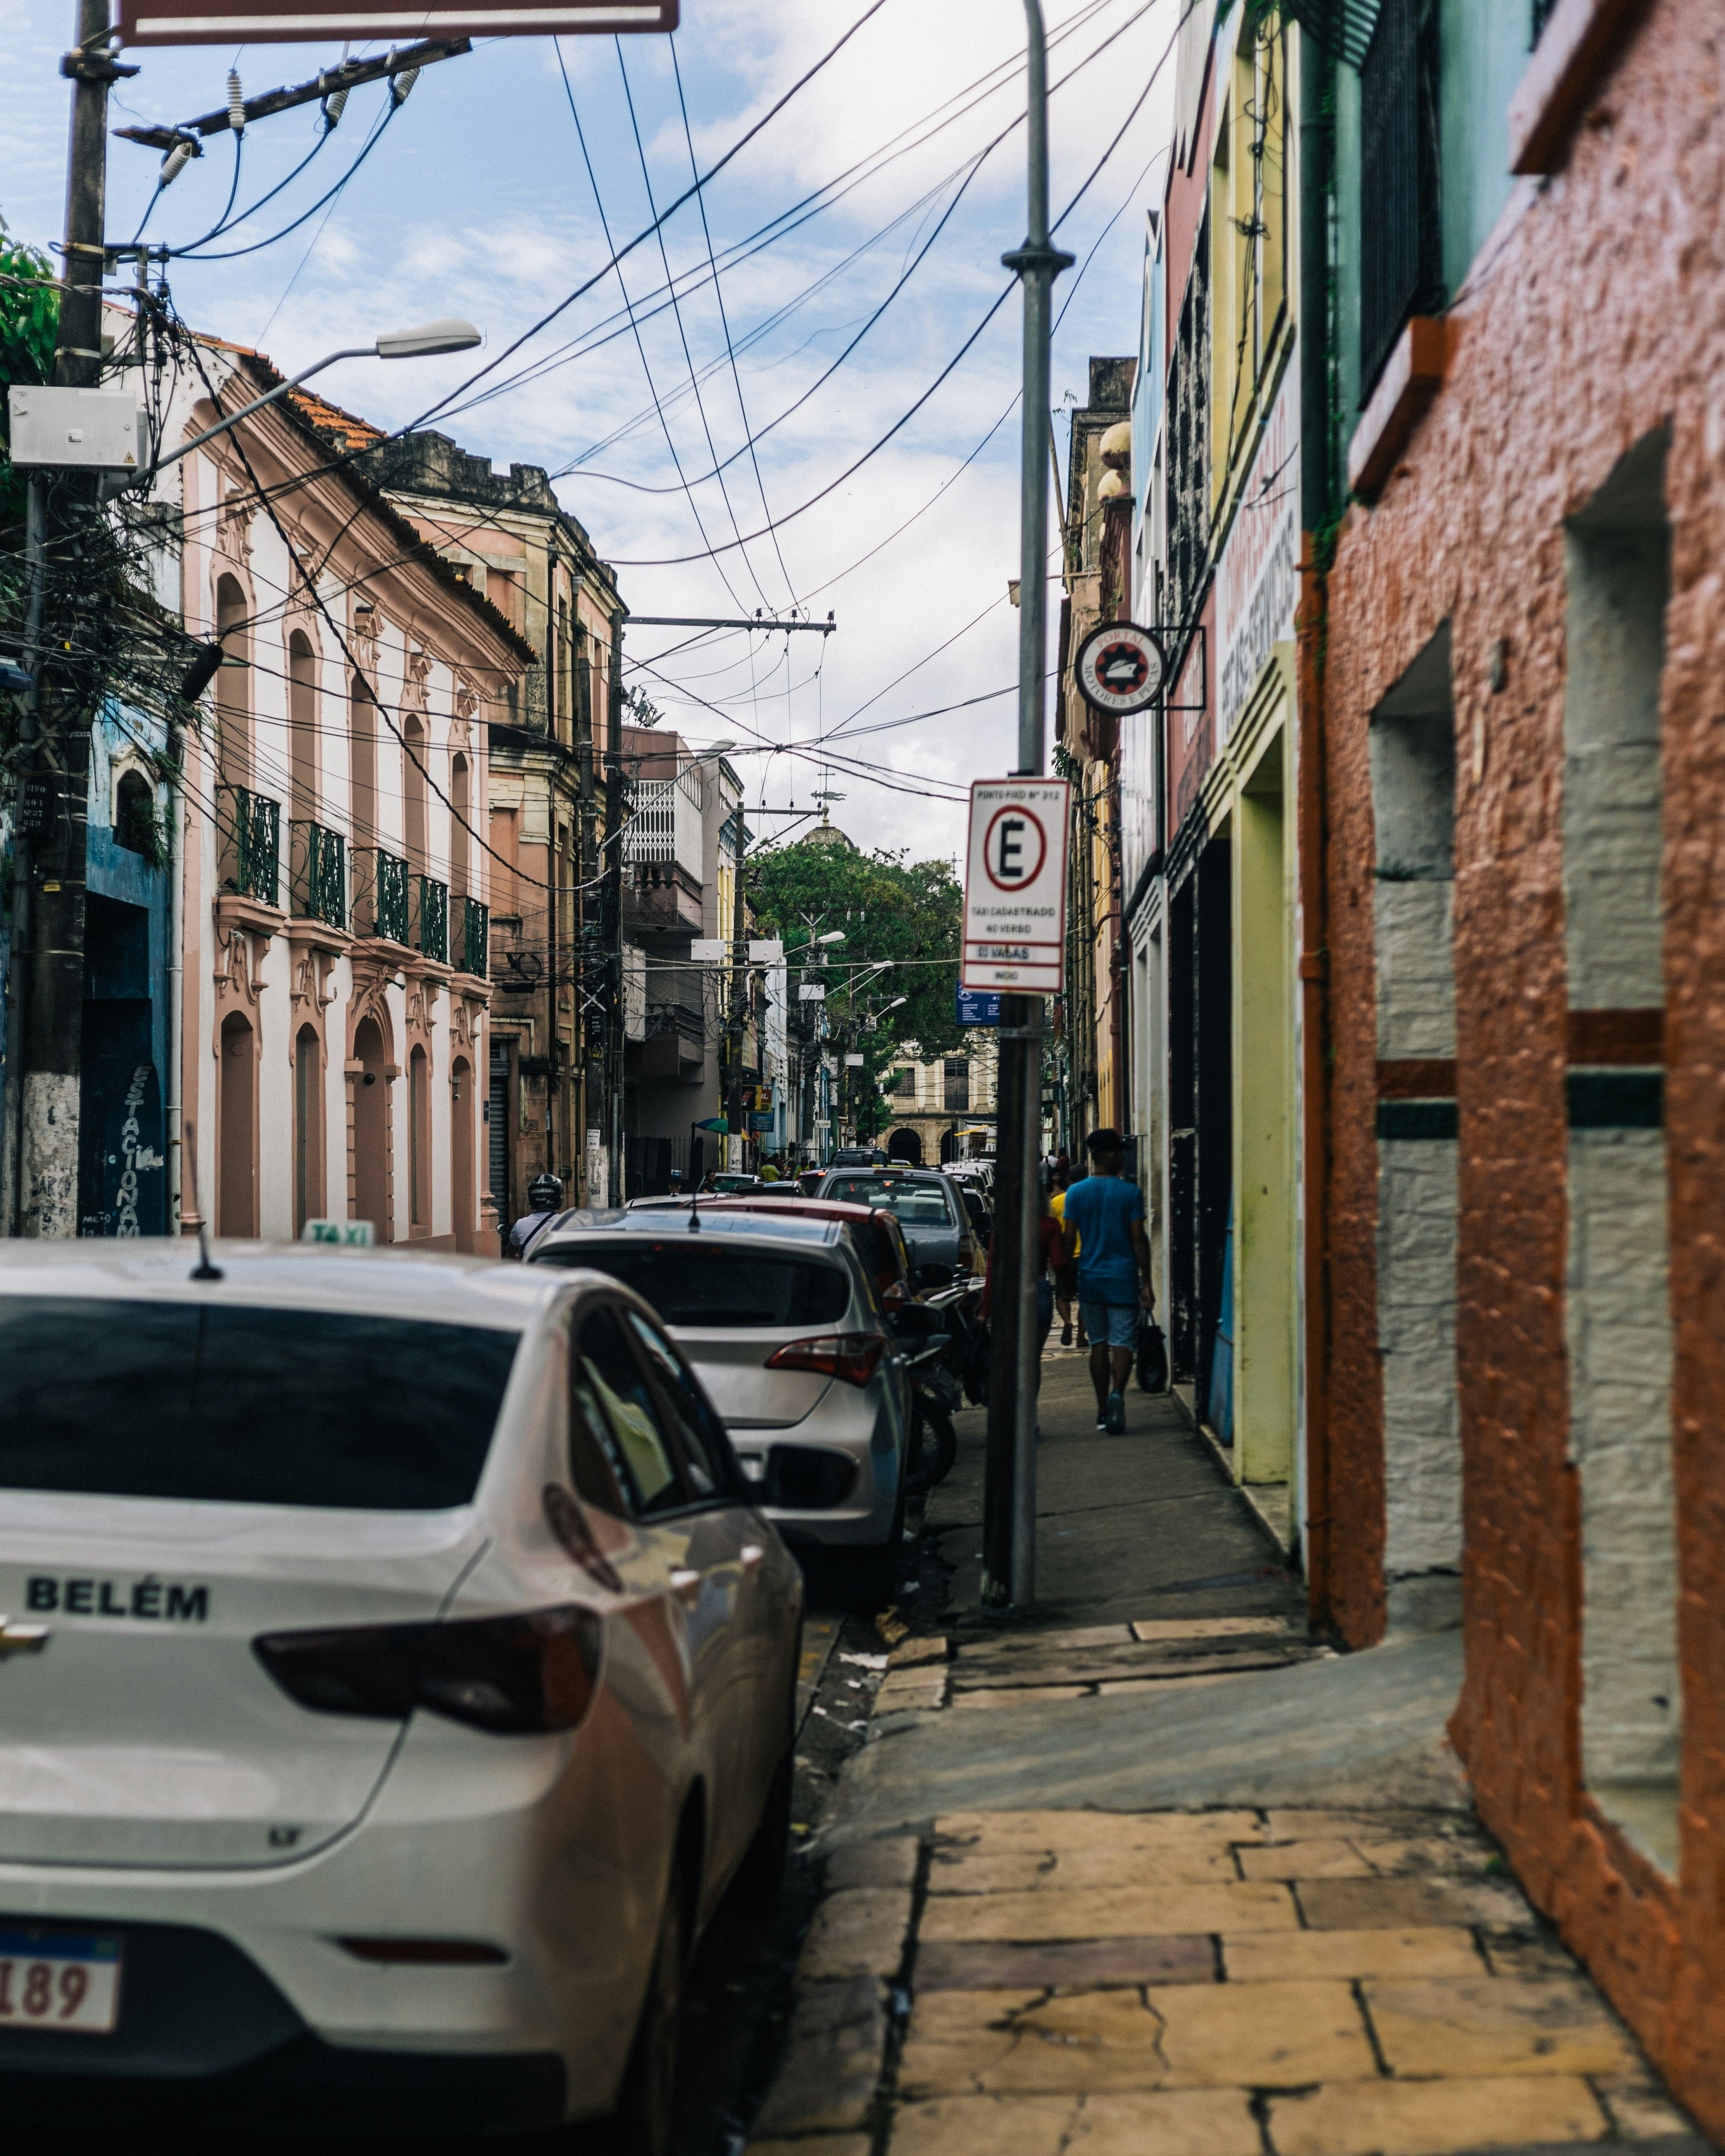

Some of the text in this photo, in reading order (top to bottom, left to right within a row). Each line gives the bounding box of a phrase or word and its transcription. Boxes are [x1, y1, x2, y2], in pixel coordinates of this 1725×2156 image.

[1096, 631, 1144, 647] PORTAL
[1085, 664, 1126, 705] MOTORES
[27, 784, 45, 793] VIVO
[978, 789, 1004, 799] PONTO
[999, 819, 1025, 877] E
[990, 907, 1055, 917] CADASTRADO
[986, 924, 1031, 934] NO VERSO
[992, 946, 1029, 960] VAGAS
[312, 1224, 367, 1244] TAXI
[26, 1572, 208, 1622] BELÉM
